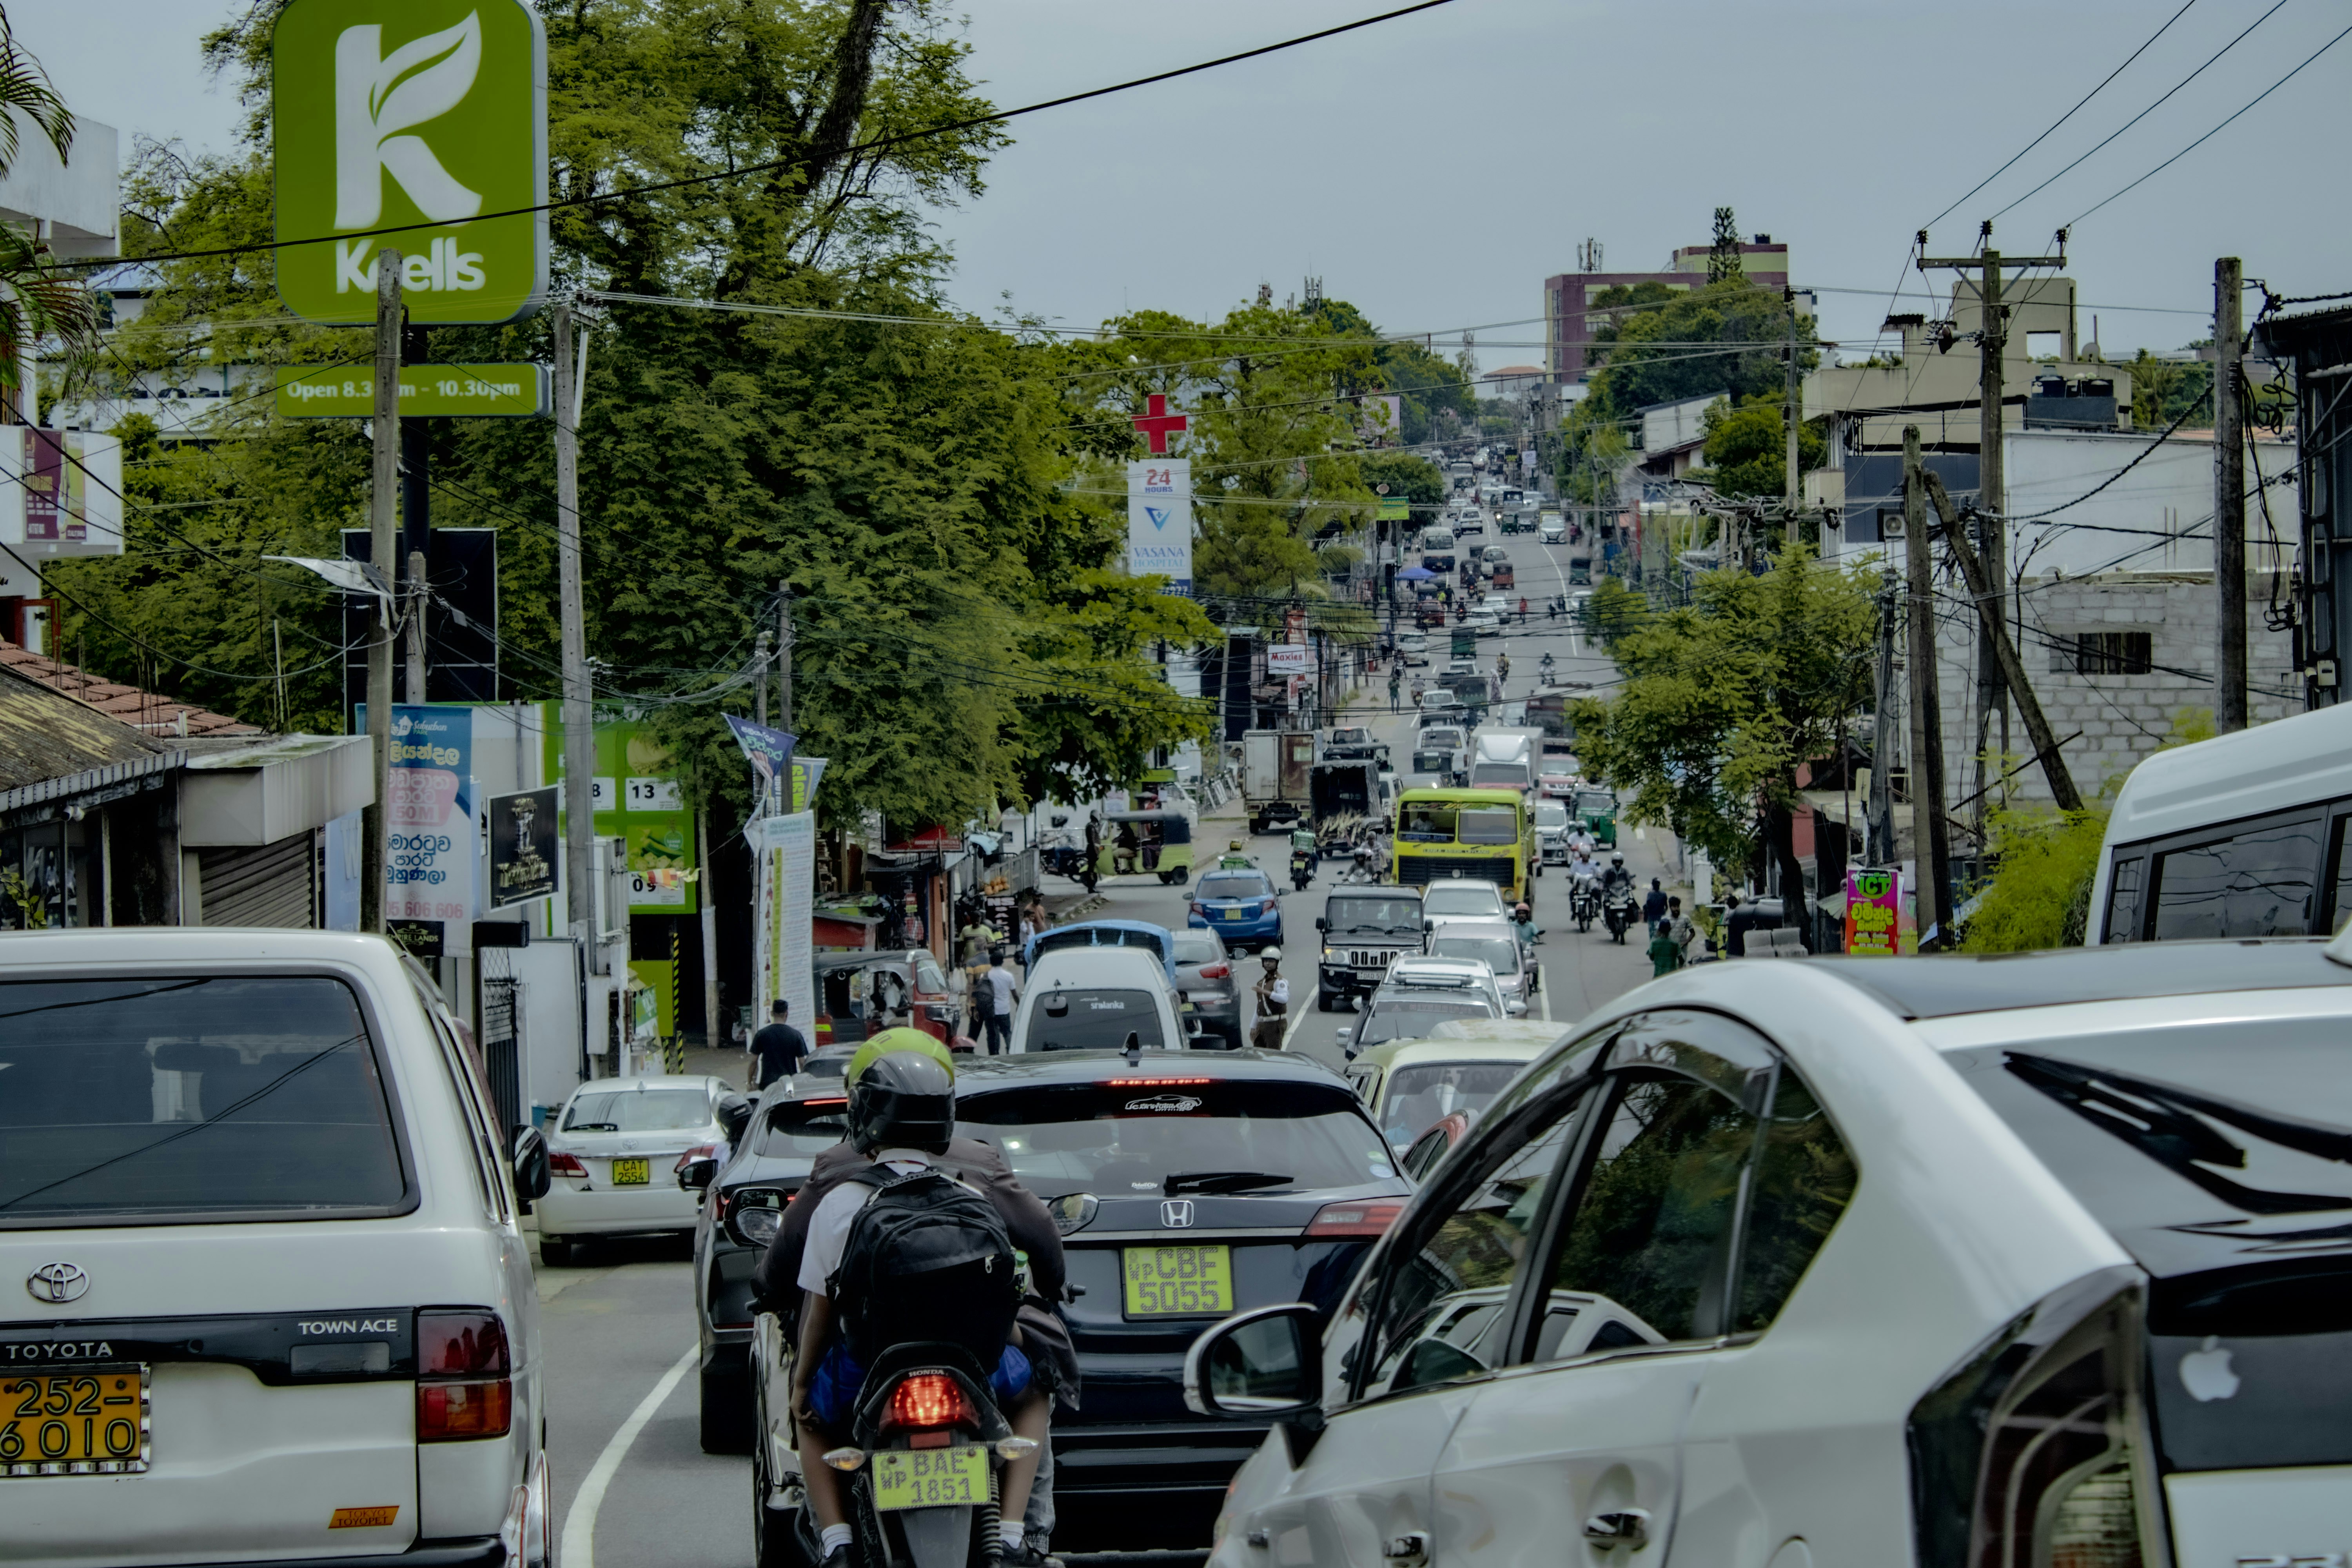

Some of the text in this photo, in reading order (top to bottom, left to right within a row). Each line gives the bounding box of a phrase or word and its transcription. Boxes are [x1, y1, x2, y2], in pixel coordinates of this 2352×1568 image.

[287, 381, 338, 403] Open
[342, 382, 416, 398] 8.3m
[438, 379, 520, 401] 10.30pm
[1146, 468, 1171, 486] 24
[1134, 547, 1185, 557] VASANA
[1134, 559, 1186, 568] HOSPITAL
[1271, 653, 1303, 661] Maxies
[413, 720, 448, 731] Suburban
[390, 740, 460, 766] ළියන්දල
[396, 806, 416, 819] 50
[1859, 876, 1892, 895] ICT
[404, 902, 431, 918] 606
[435, 902, 464, 919] 606
[414, 934, 439, 942] LANDS
[622, 1161, 644, 1172] CAT
[618, 1172, 644, 1183] 2554
[1156, 1247, 1218, 1279] CBF
[1139, 1280, 1220, 1312] 5055
[298, 1319, 397, 1335] TOWN ACE
[5, 1341, 113, 1359] TOYOTA
[908, 1369, 945, 1377] HONDA
[0, 1418, 136, 1460] 6010
[913, 1452, 972, 1477] BAE
[910, 1477, 973, 1504] 1851
[336, 1516, 388, 1526] TOYOPET
[347, 1509, 387, 1518] TOKYO
